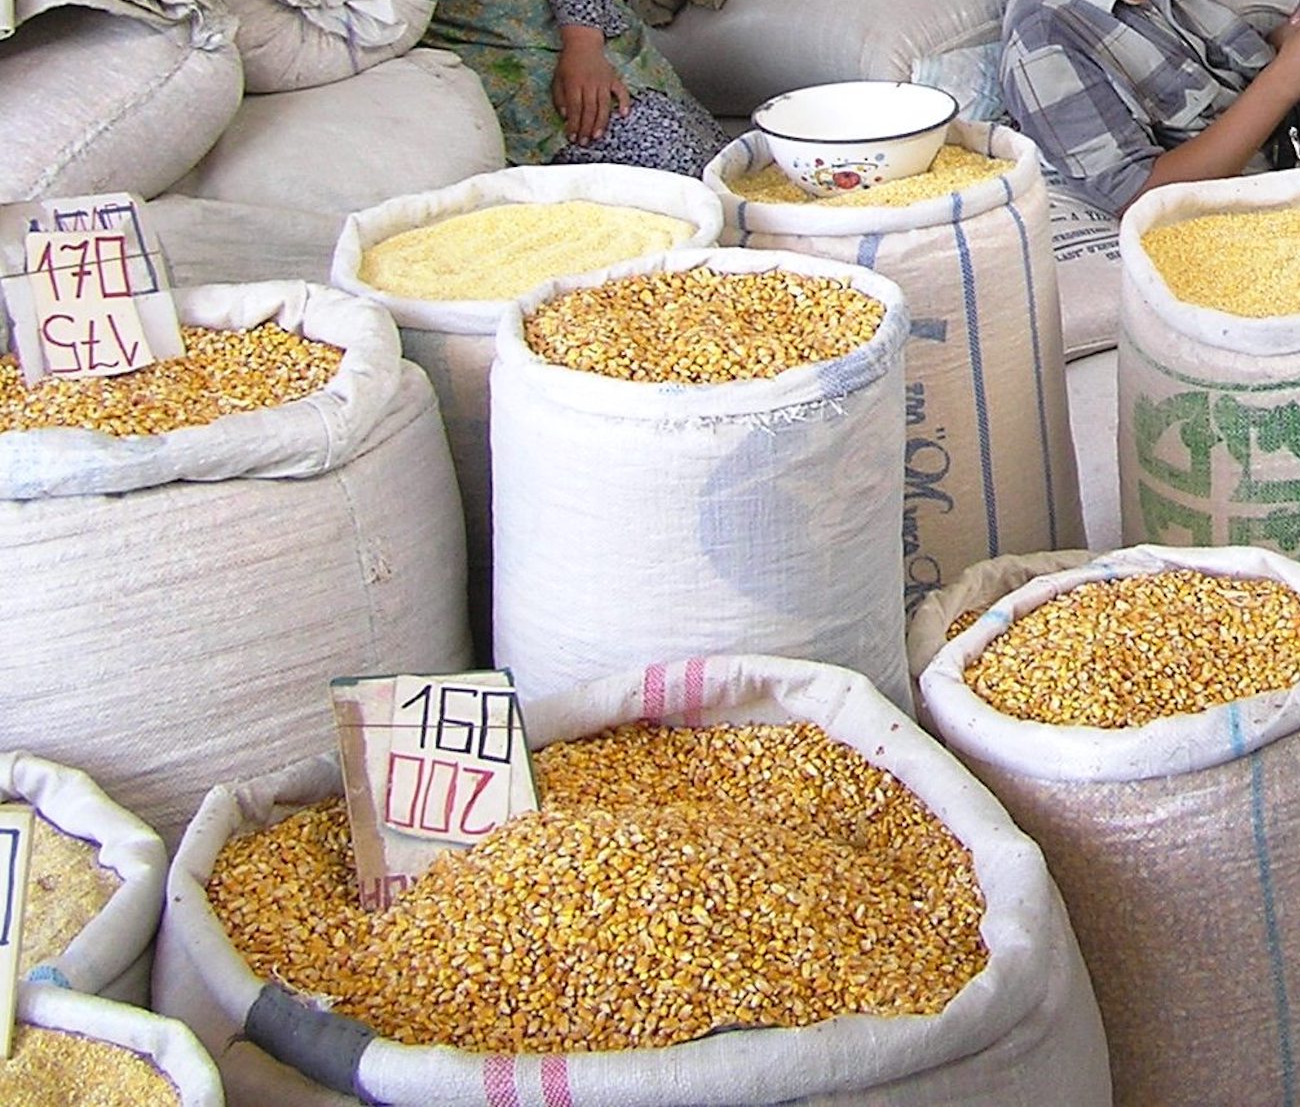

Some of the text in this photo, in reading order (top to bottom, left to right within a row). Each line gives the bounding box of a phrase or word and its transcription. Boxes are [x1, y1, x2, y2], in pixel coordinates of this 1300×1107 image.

[37, 236, 131, 300] 170
[401, 684, 516, 764] 160
[385, 752, 496, 834] 200
